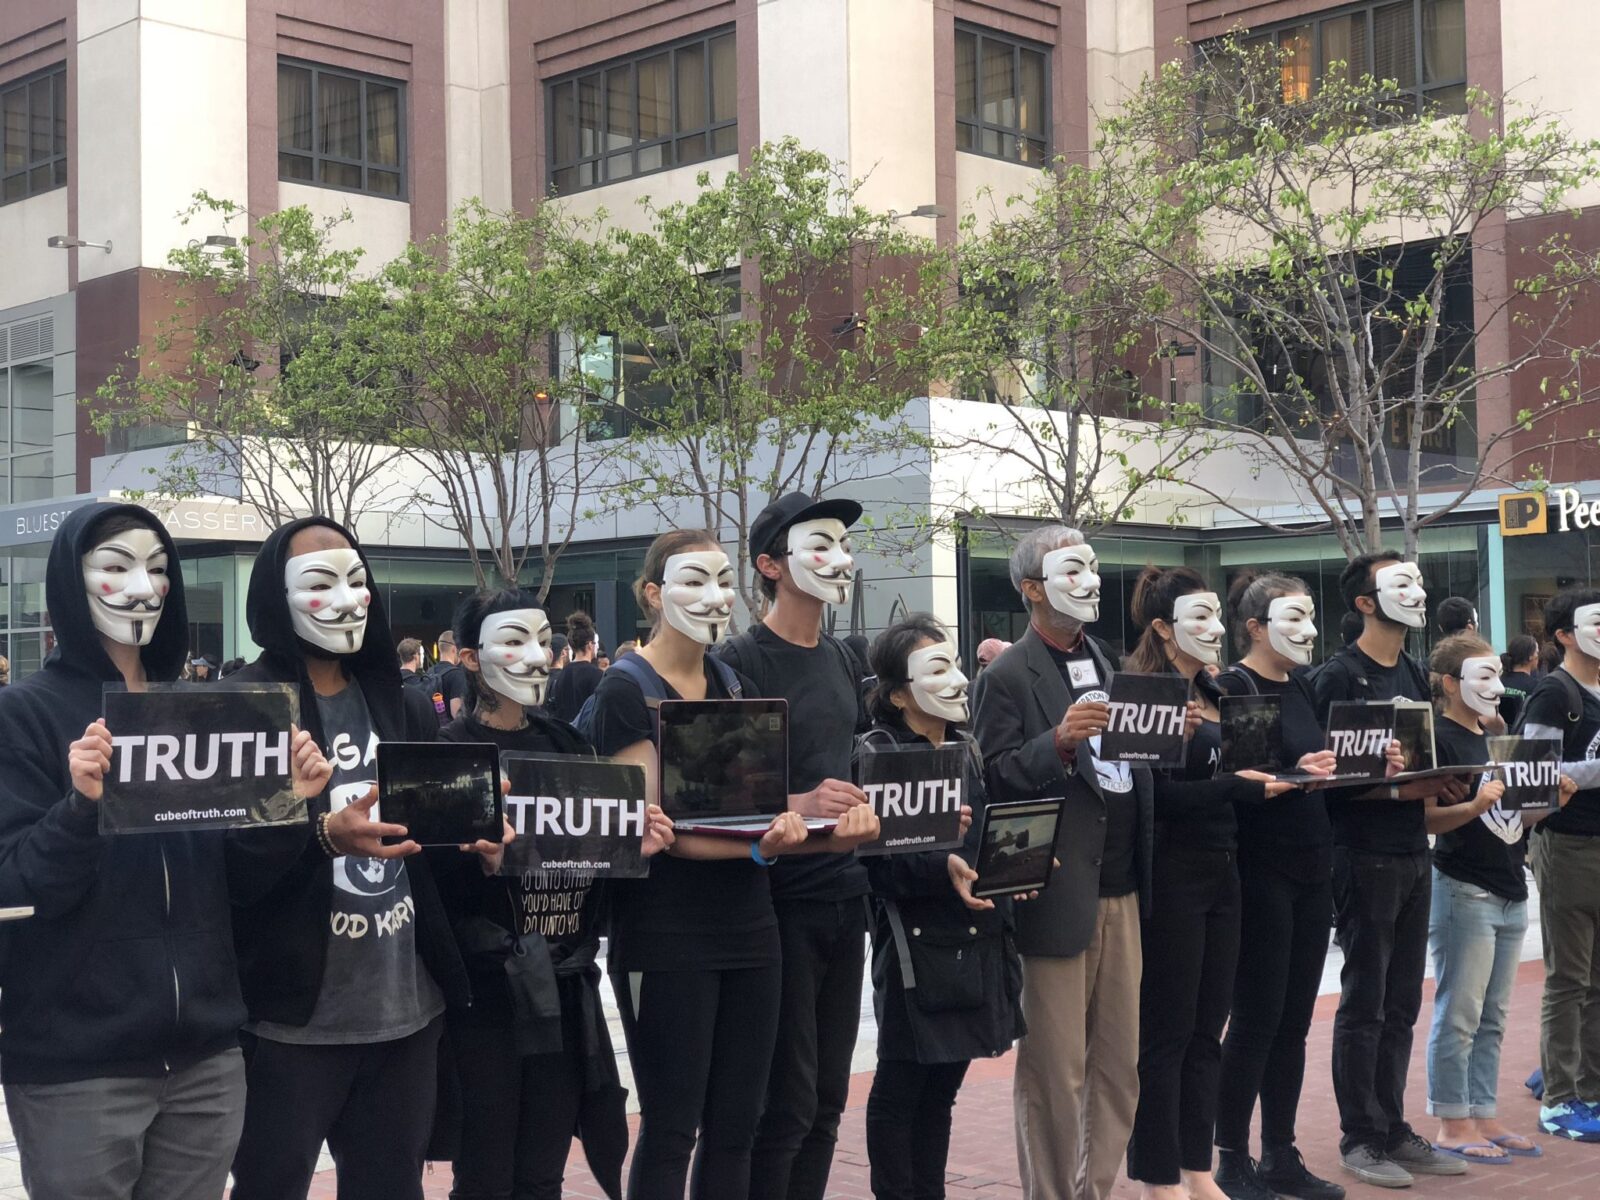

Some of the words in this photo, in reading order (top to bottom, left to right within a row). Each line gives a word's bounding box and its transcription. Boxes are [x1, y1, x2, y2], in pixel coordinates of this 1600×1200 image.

[154, 509, 273, 533] ASSERI
[1554, 488, 1600, 532] Pee
[1107, 701, 1188, 736] TRUTH
[1330, 728, 1393, 758] TRUTH
[111, 731, 289, 783] TRUTH
[1498, 761, 1560, 788] TRUTH
[863, 778, 962, 818] TRUTH
[154, 808, 247, 822] cubeoftruth.com
[505, 795, 645, 837] TRUTH
[541, 860, 611, 869] cubeoftruth.com
[534, 869, 561, 890] UNTO
[521, 893, 549, 913] YOU'D
[550, 892, 572, 912] HAVE
[330, 911, 369, 939] OD
[540, 914, 566, 936] UNTO
